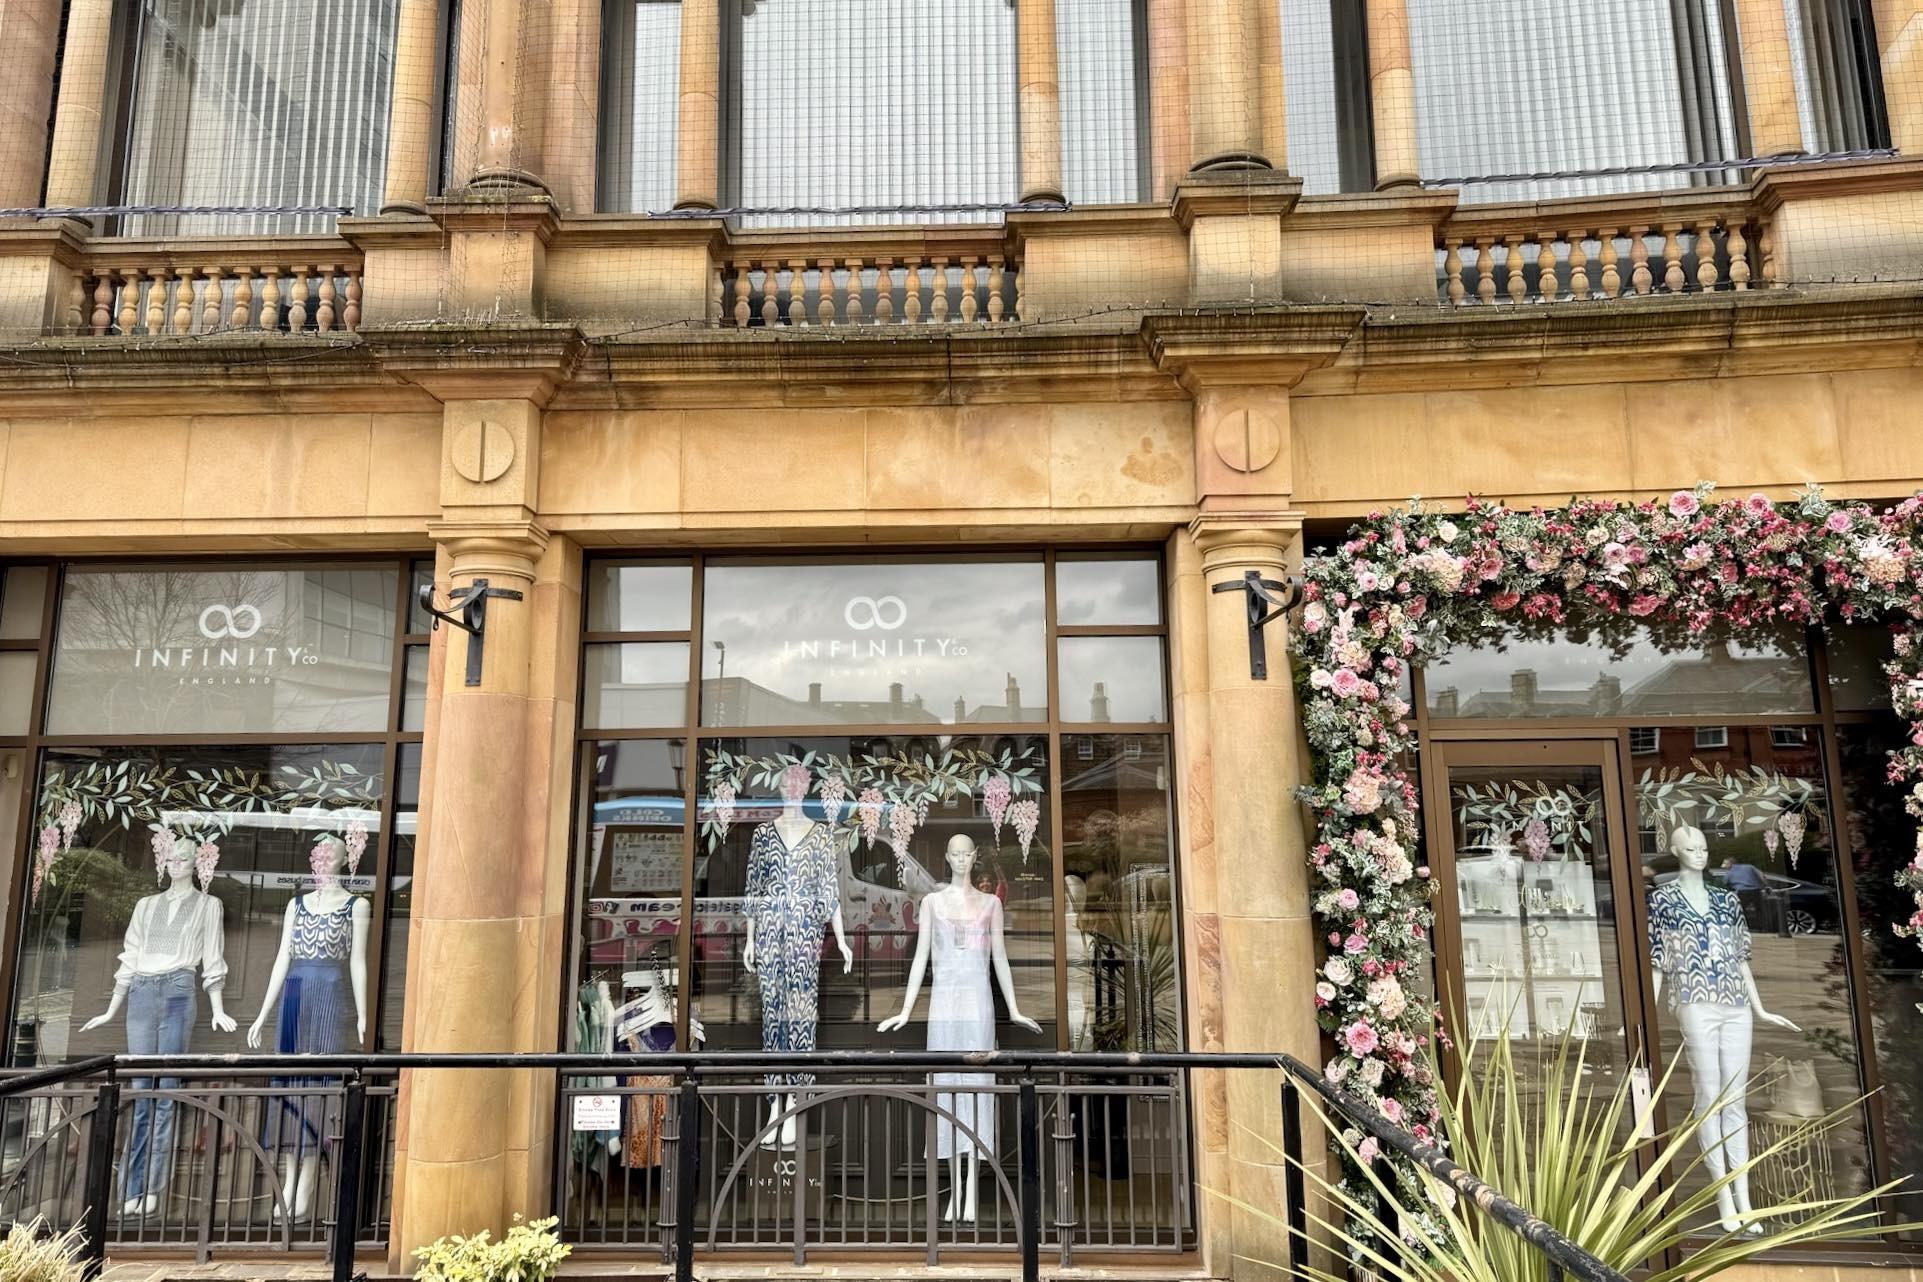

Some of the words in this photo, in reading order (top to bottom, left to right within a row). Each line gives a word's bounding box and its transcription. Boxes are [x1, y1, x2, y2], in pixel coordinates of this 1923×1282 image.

[784, 639, 951, 658] INFINITY
[135, 647, 303, 667] INFINITY
[179, 677, 271, 685] ENGLAND
[749, 1178, 814, 1187] INFNY
